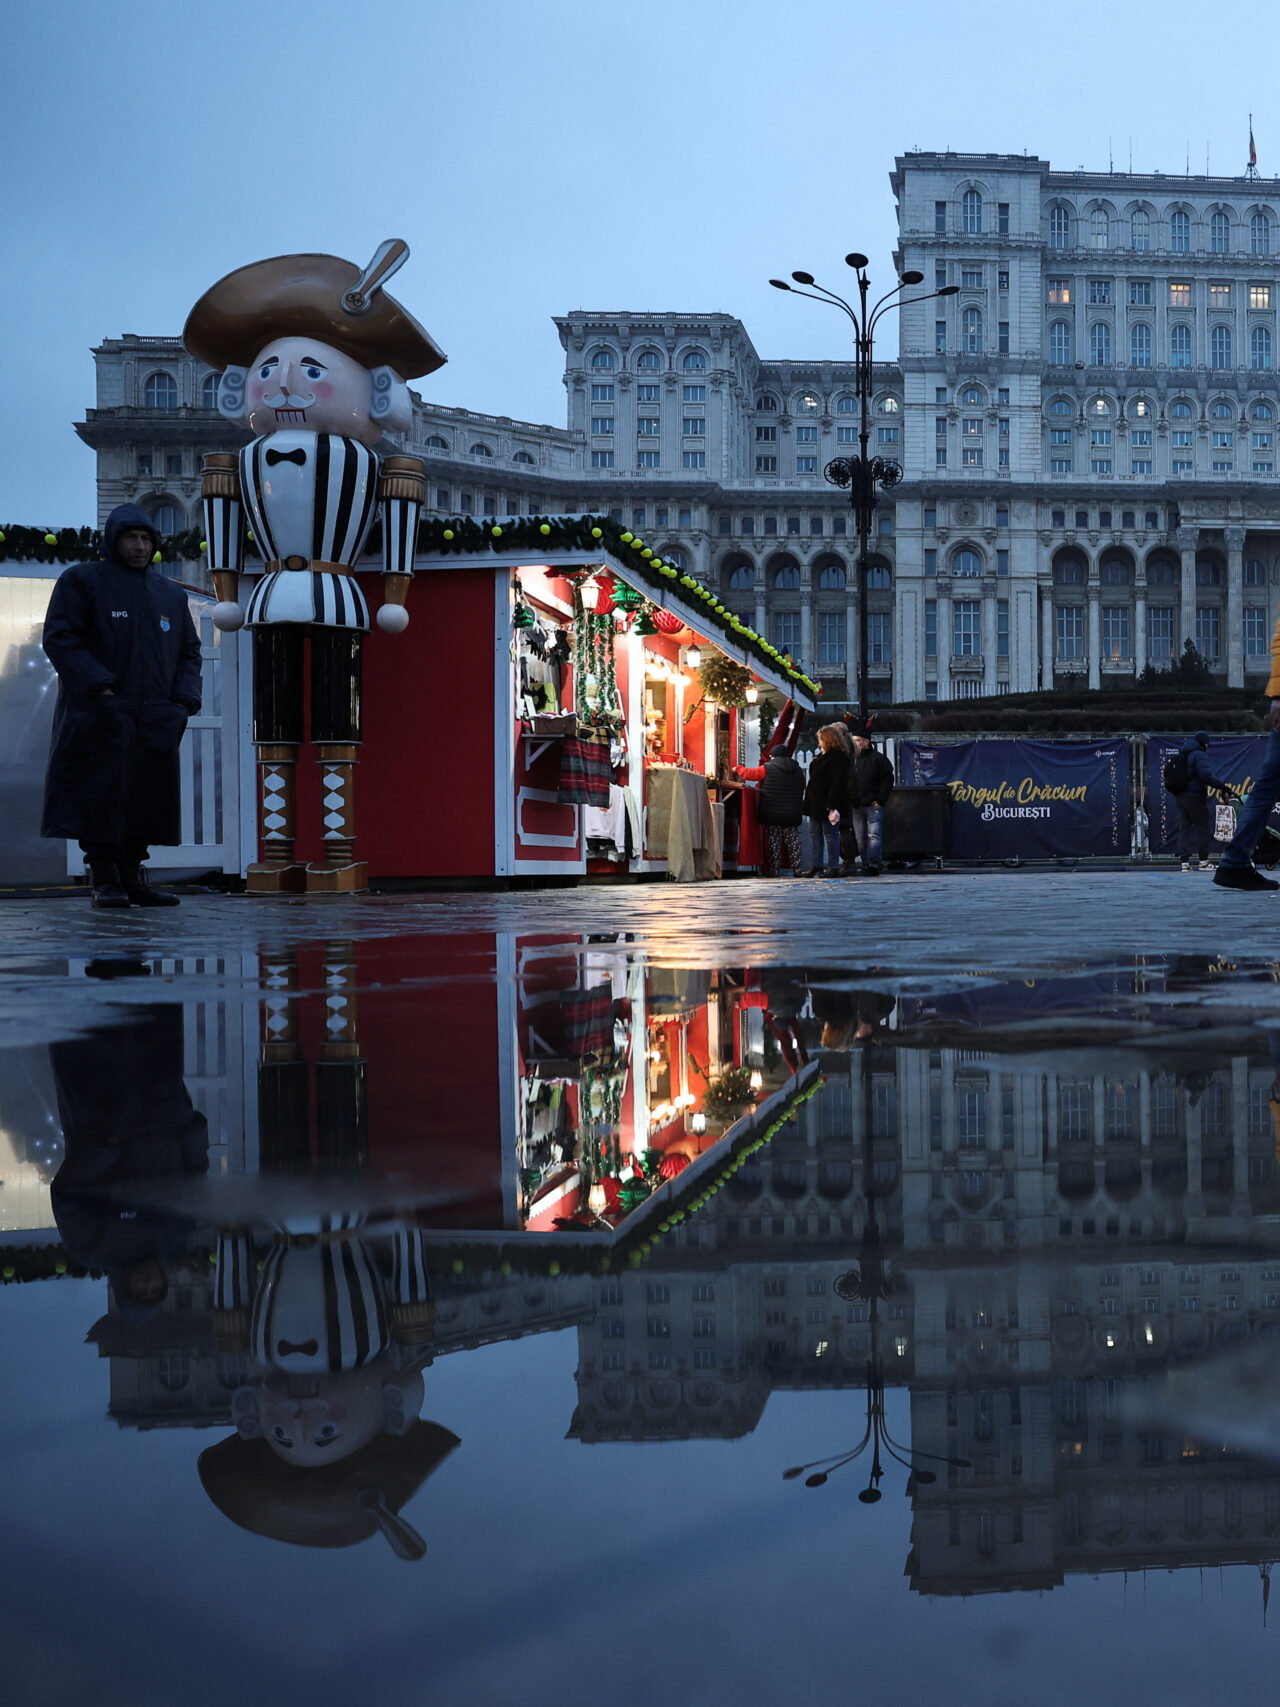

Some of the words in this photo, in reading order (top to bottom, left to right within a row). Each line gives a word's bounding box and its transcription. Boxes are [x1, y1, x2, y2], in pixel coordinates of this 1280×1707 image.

[946, 780, 1007, 808] Târgul
[1003, 786, 1015, 798] de
[1017, 777, 1088, 804] Crăciun
